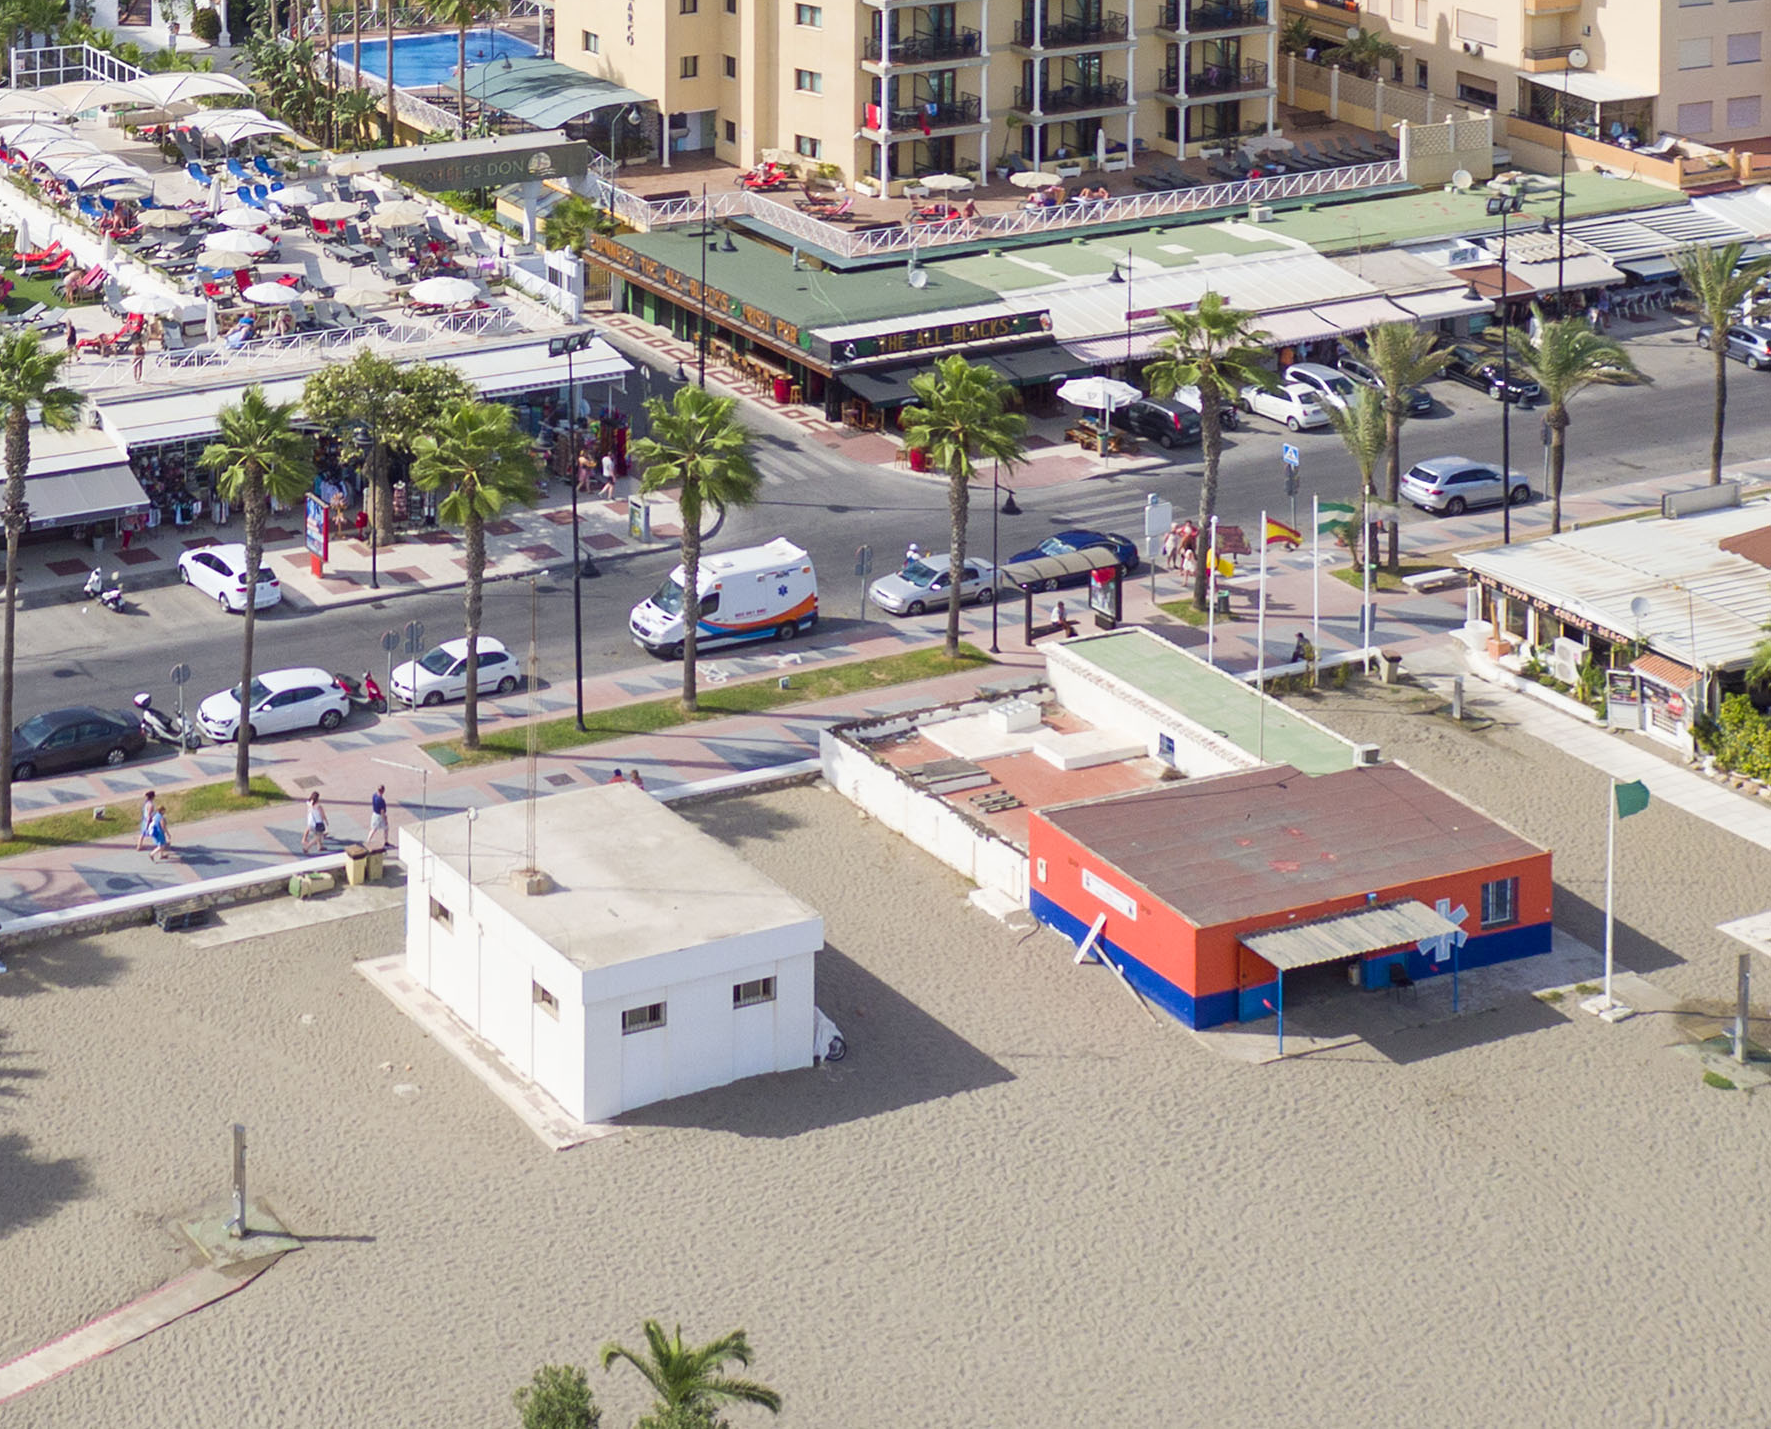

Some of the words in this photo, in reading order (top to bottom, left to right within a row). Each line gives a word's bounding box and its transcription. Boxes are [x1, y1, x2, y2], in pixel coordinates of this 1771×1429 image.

[488, 159, 524, 176] DON
[640, 257, 659, 280] THE
[776, 319, 797, 344] PUB
[879, 332, 906, 353] THE
[916, 328, 944, 347] ALL
[952, 318, 1009, 342] BLACKS
